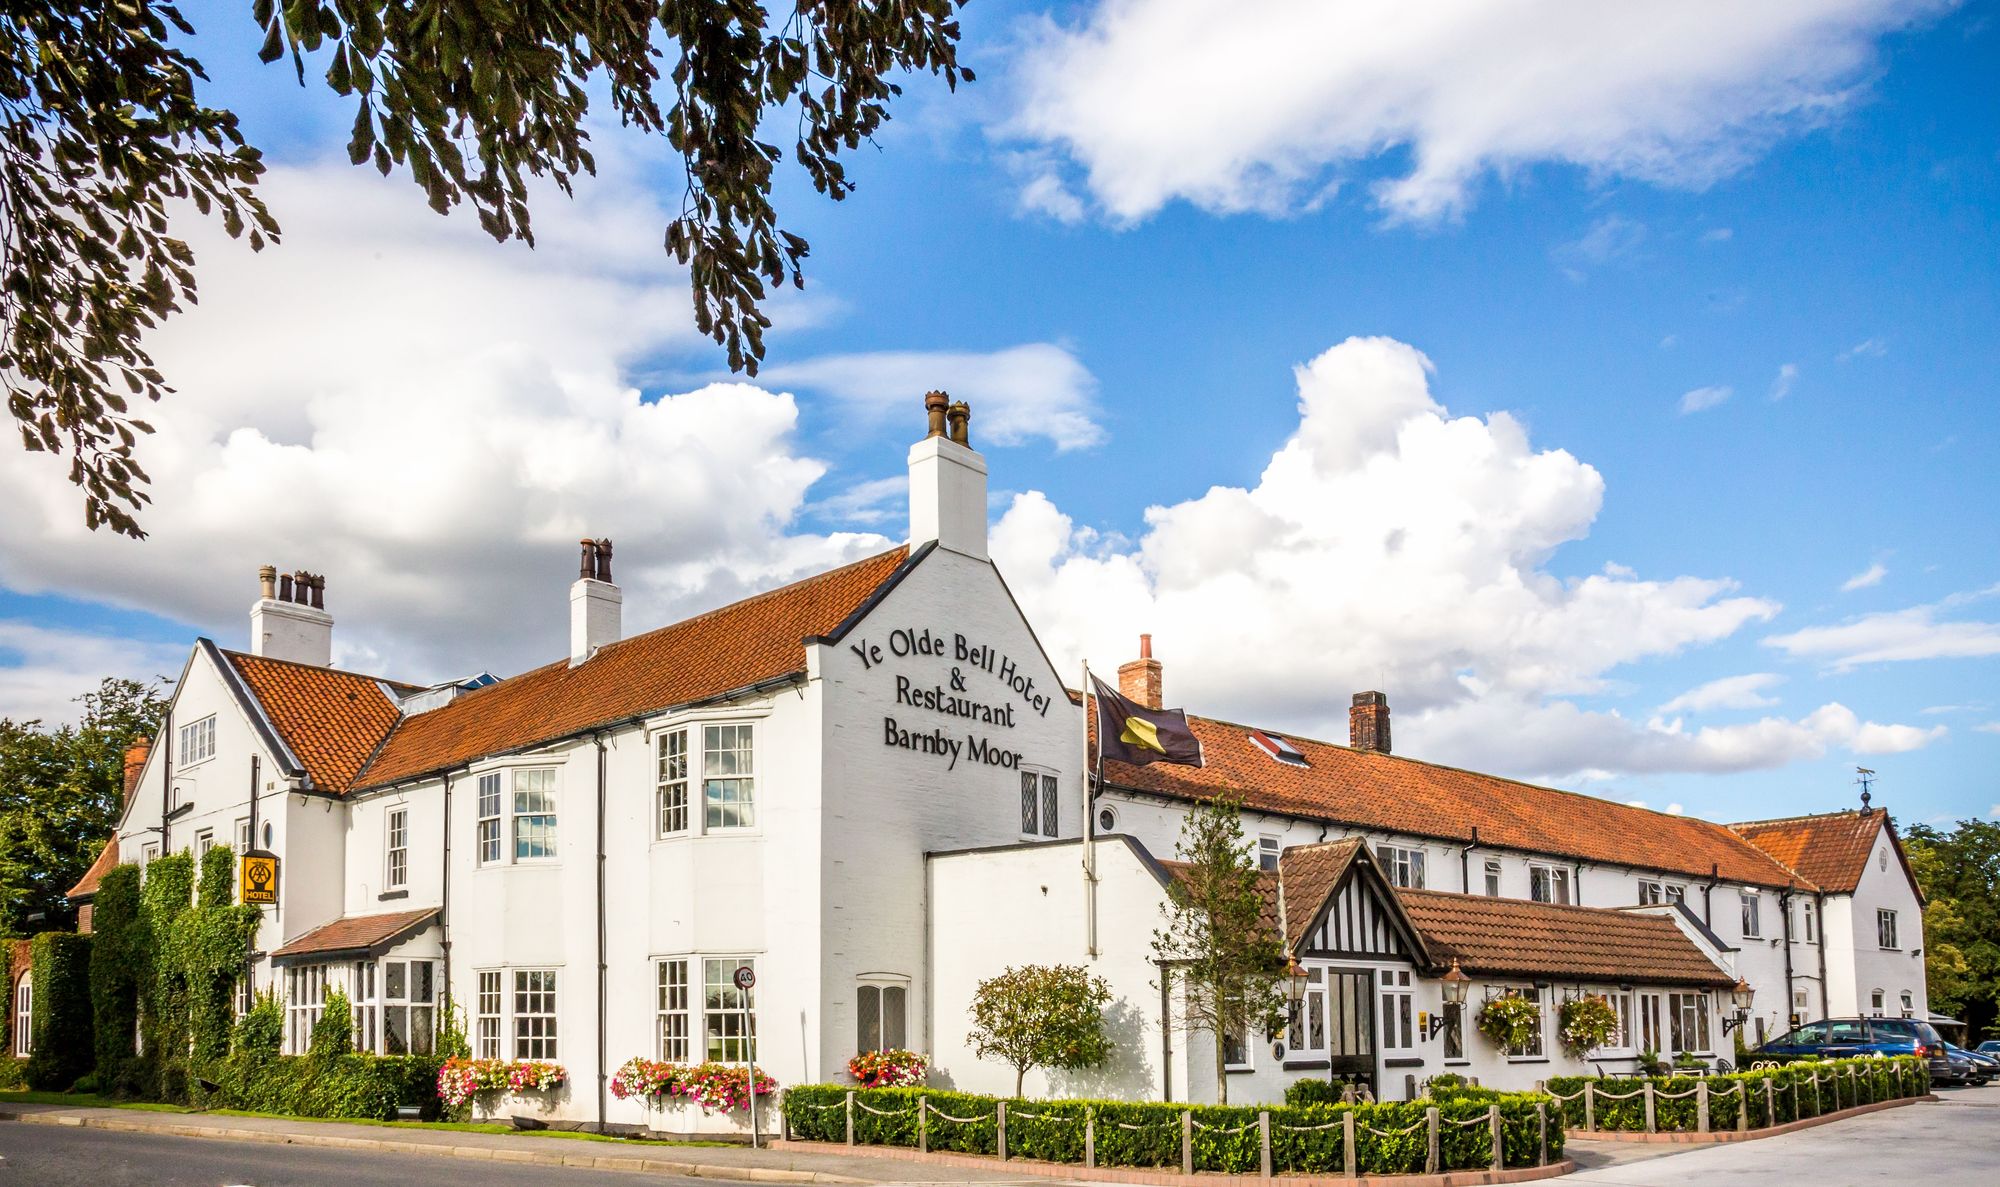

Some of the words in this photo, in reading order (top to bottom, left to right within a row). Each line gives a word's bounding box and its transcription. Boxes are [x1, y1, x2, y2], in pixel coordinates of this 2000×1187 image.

[851, 639, 884, 670] Ye
[889, 628, 945, 657] Olde
[955, 633, 995, 673] Bell
[999, 655, 1052, 718] Hotel
[950, 667, 967, 692] &
[896, 675, 1016, 728] Restaurant
[884, 717, 963, 771] Barnby
[967, 735, 1023, 770] Moor
[252, 867, 267, 881] AA
[247, 891, 273, 900] HOTEL
[740, 972, 753, 982] 40
